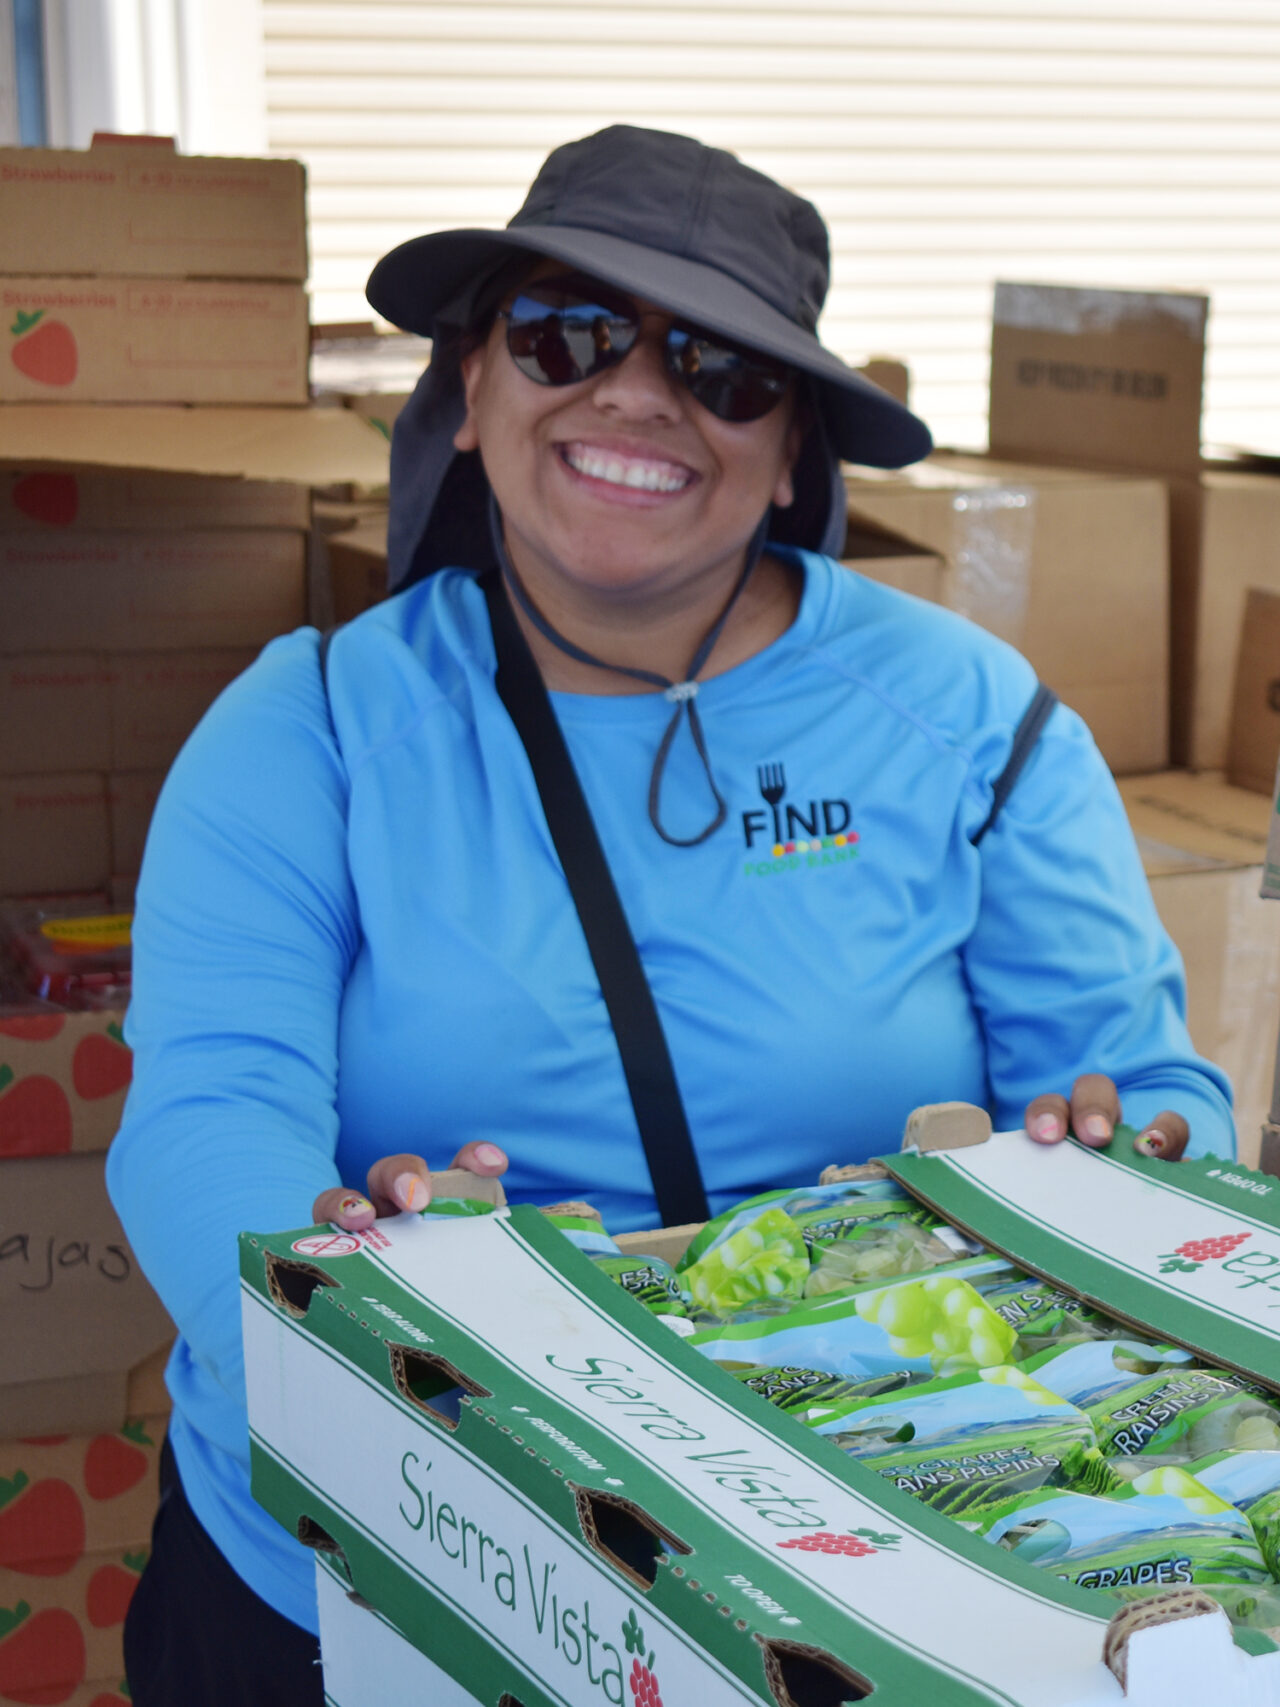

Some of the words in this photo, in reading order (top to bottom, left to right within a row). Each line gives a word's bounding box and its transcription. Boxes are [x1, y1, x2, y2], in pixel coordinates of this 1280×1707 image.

[742, 764, 852, 848] FIND
[1216, 1171, 1257, 1188] OPEN
[1111, 1380, 1192, 1422] GREEN
[545, 1354, 707, 1441] Sierra
[685, 1449, 828, 1528] Vista
[1113, 1391, 1210, 1455] RAISINS
[893, 1469, 954, 1492] ANS
[399, 1451, 516, 1611] Sierra
[523, 1544, 626, 1707] Vista
[1076, 1560, 1193, 1590] GRAPES
[741, 1587, 789, 1614] OPEN
